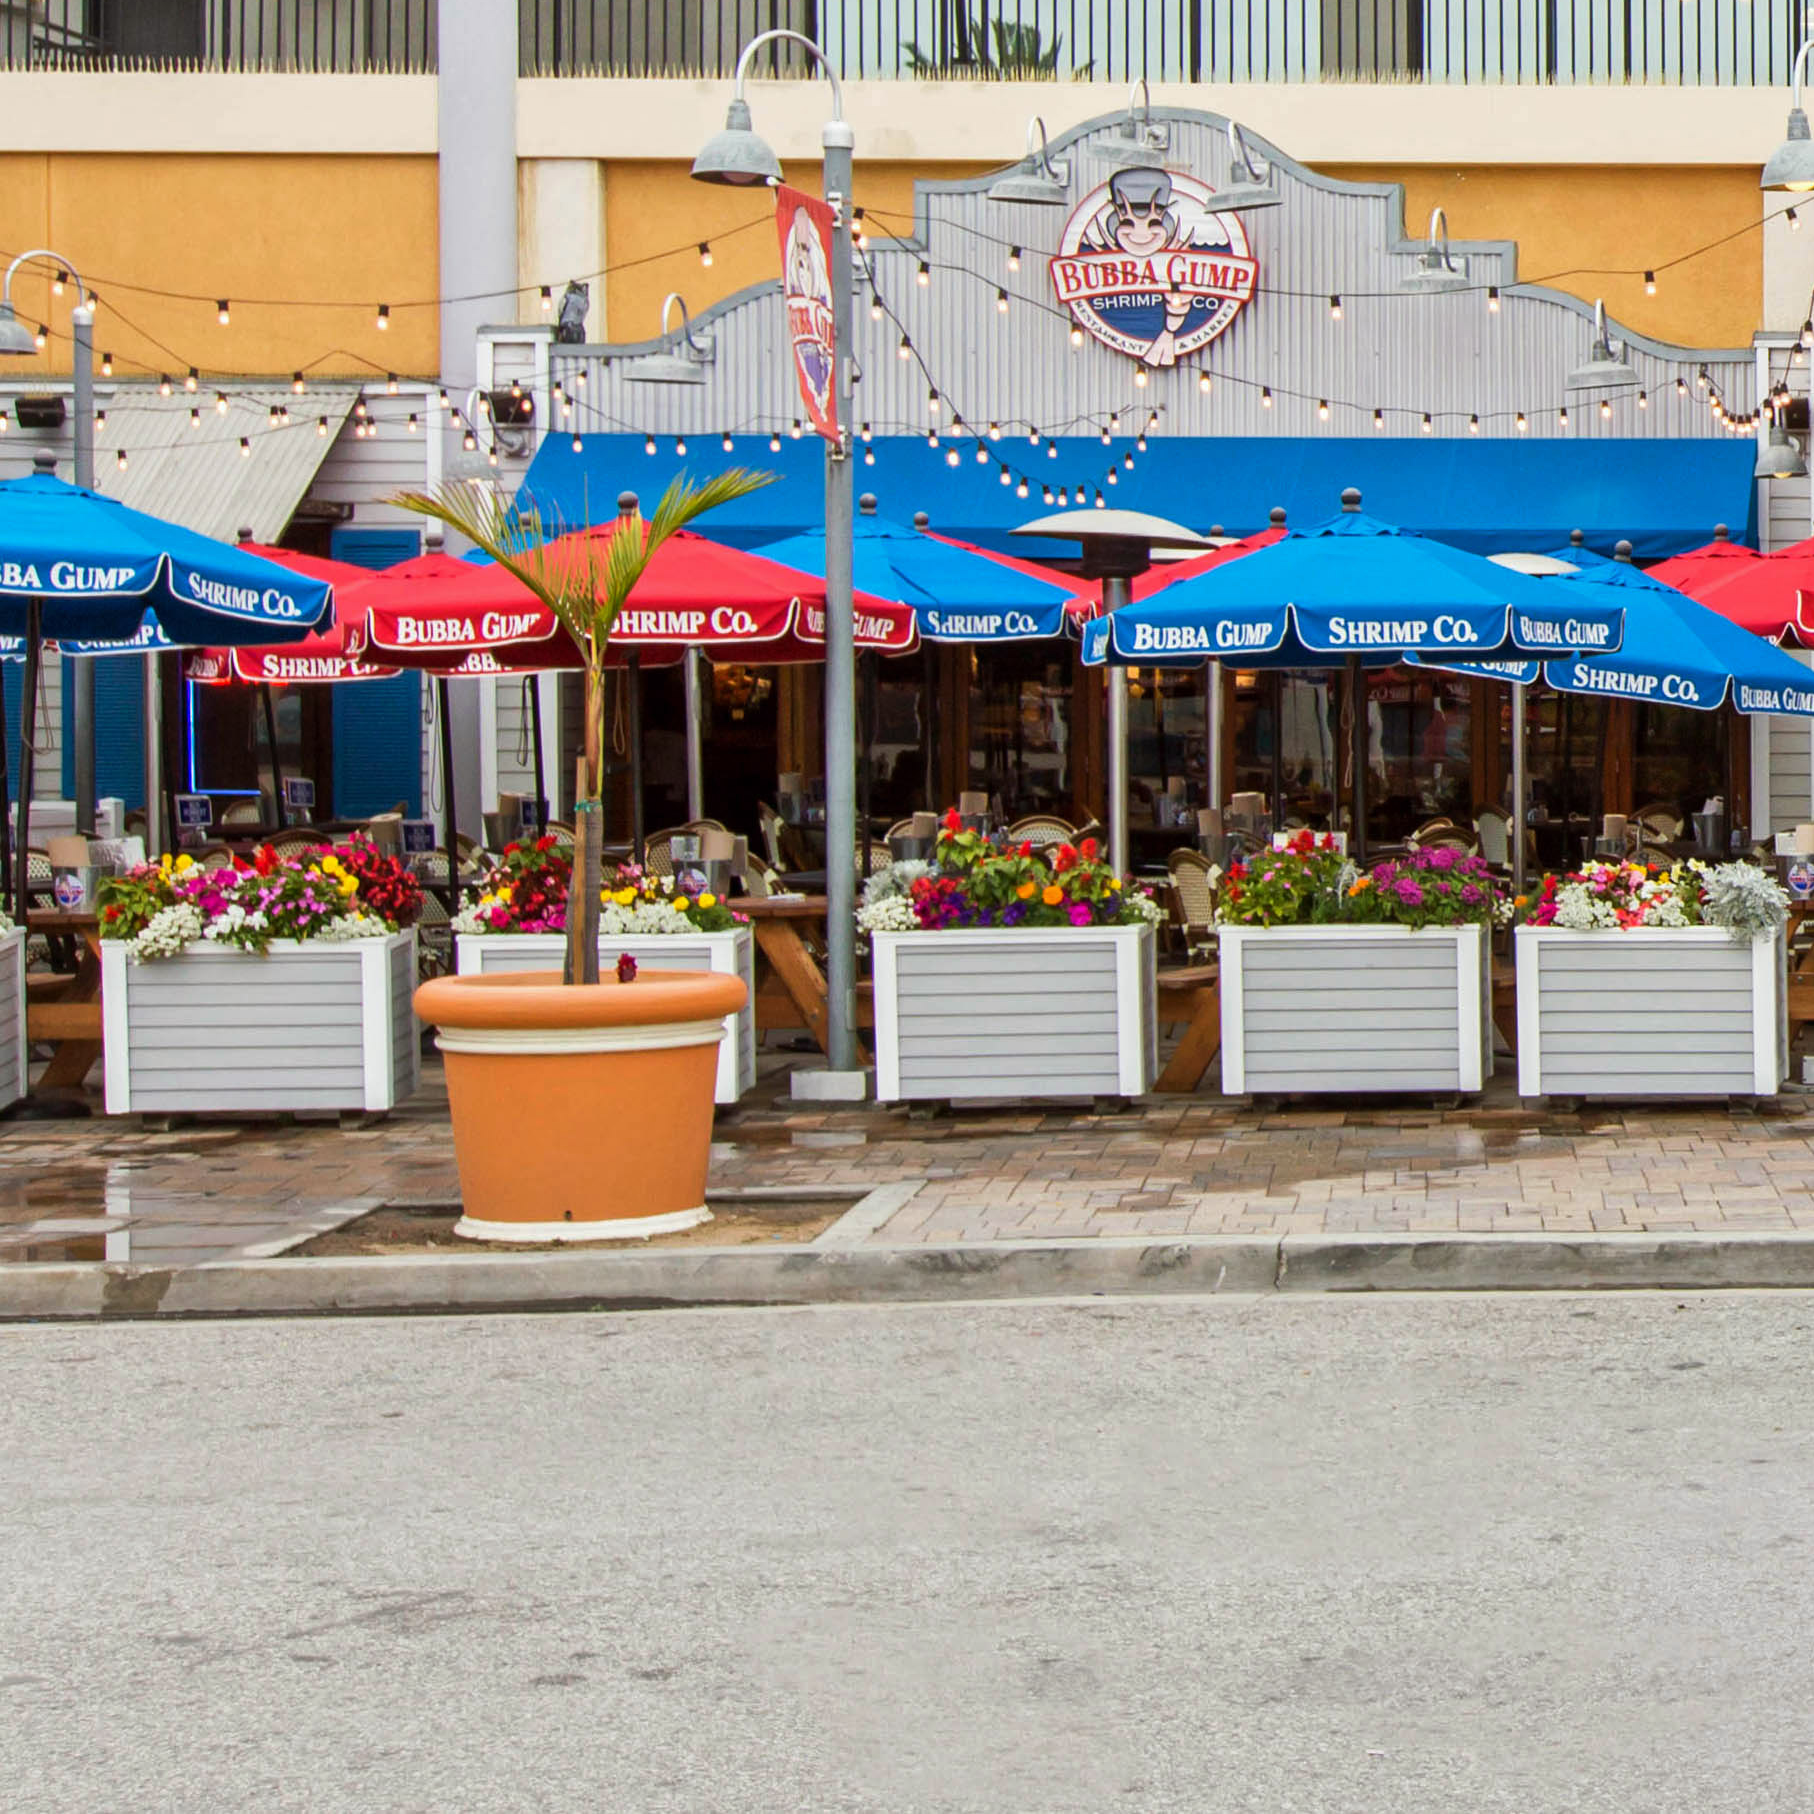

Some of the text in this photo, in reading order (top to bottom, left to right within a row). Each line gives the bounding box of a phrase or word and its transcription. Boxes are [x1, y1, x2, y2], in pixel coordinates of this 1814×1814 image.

[1059, 254, 1250, 293] BUBBA GUMP
[1093, 294, 1164, 310] SHRIMP
[1074, 300, 1145, 353] RESTAURANT
[1191, 303, 1235, 344] MARKET
[188, 572, 302, 617] SHRIMP CO.
[396, 617, 476, 644] BUBBA
[711, 607, 758, 633] CO.
[1004, 610, 1038, 633] CO.
[1328, 615, 1478, 645] SHRIMP CO.
[1519, 616, 1610, 645] BUBBA GUMP
[1133, 624, 1210, 650] BUBBA
[1216, 621, 1273, 647] GUMP
[262, 654, 344, 678] SHRIMP
[1572, 663, 1700, 702] SHRIMP CO.
[1740, 685, 1781, 710] BUBBA
